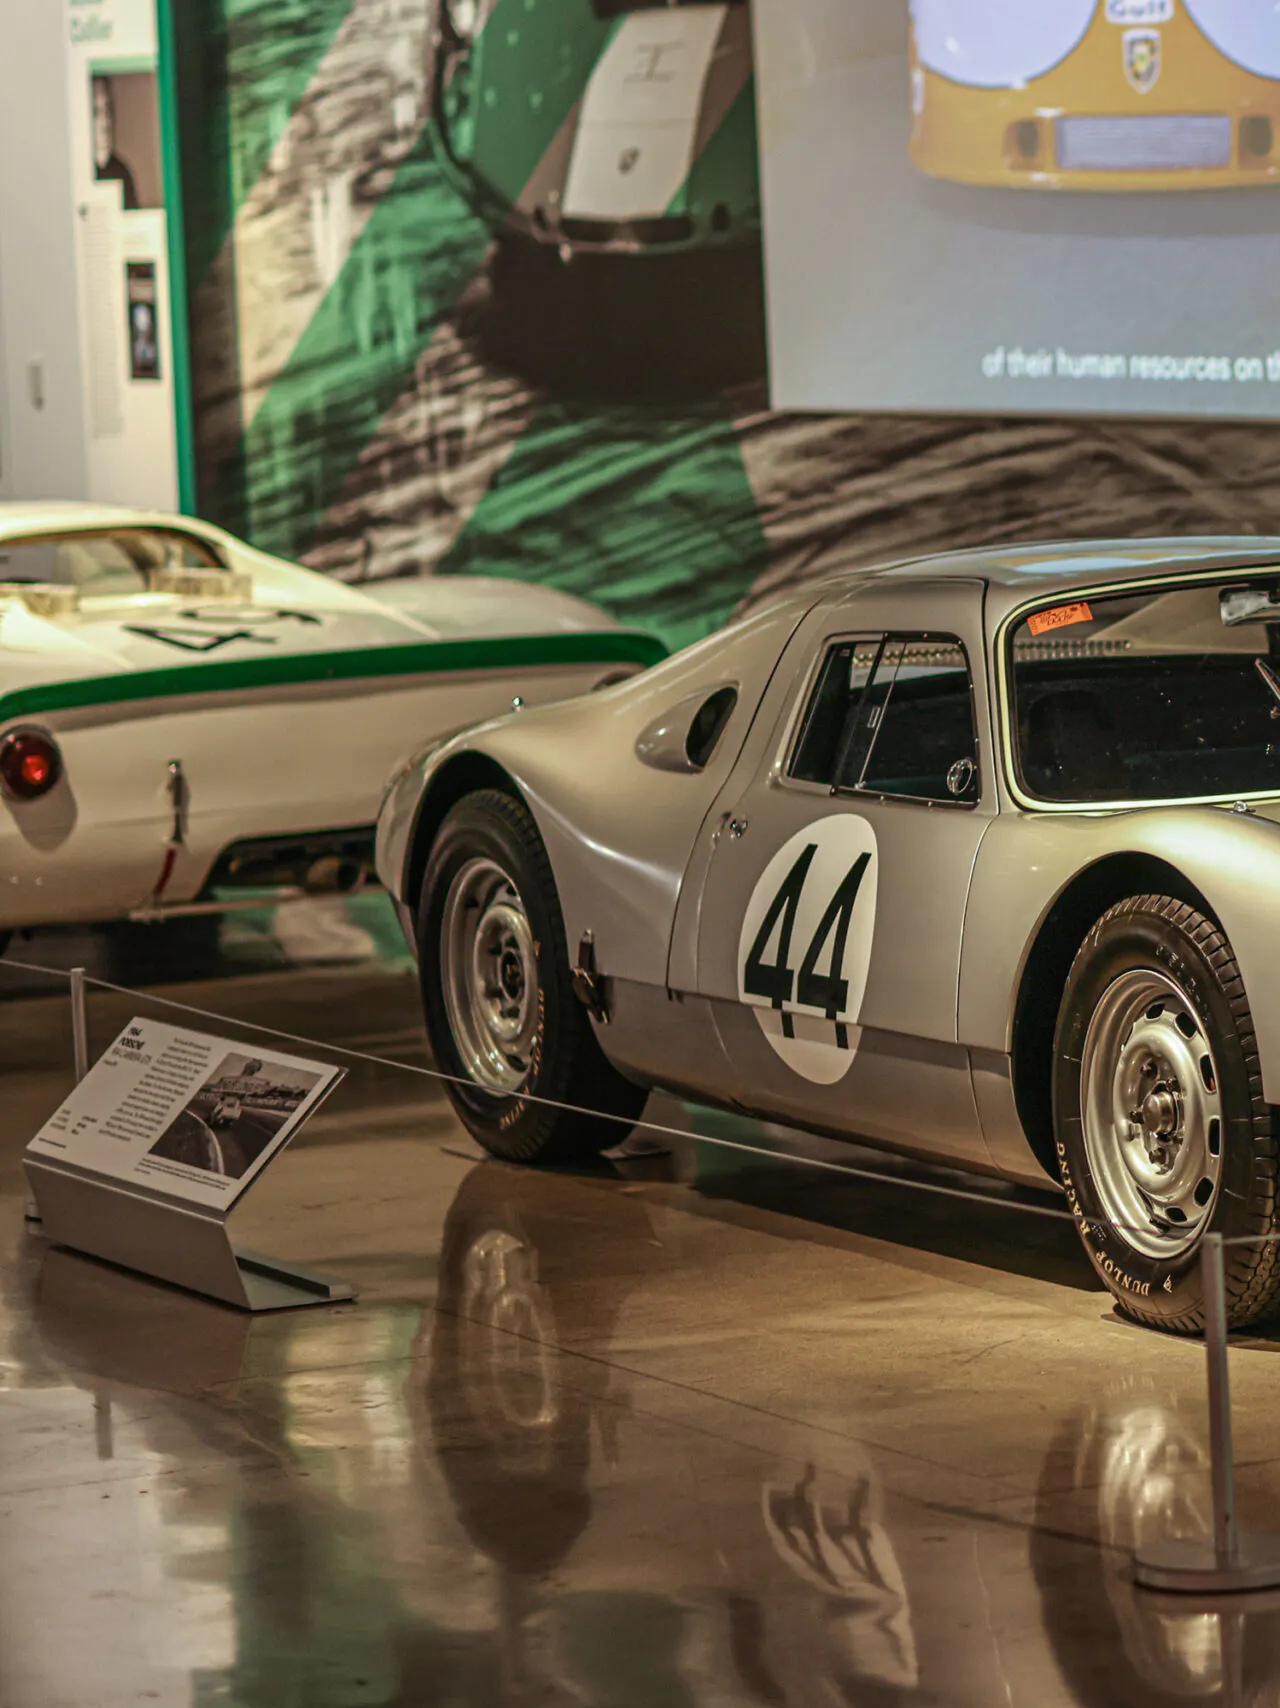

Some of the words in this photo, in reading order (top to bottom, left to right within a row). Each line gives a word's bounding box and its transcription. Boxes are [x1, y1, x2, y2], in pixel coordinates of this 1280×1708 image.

[982, 345, 1005, 378] of
[1007, 346, 1052, 378] their
[1056, 347, 1126, 379] human
[1130, 354, 1231, 381] resources
[1234, 356, 1264, 382] on
[744, 843, 872, 1050] 44
[1057, 1142, 1091, 1236] RACING
[1096, 1251, 1151, 1297] DUNLOP
